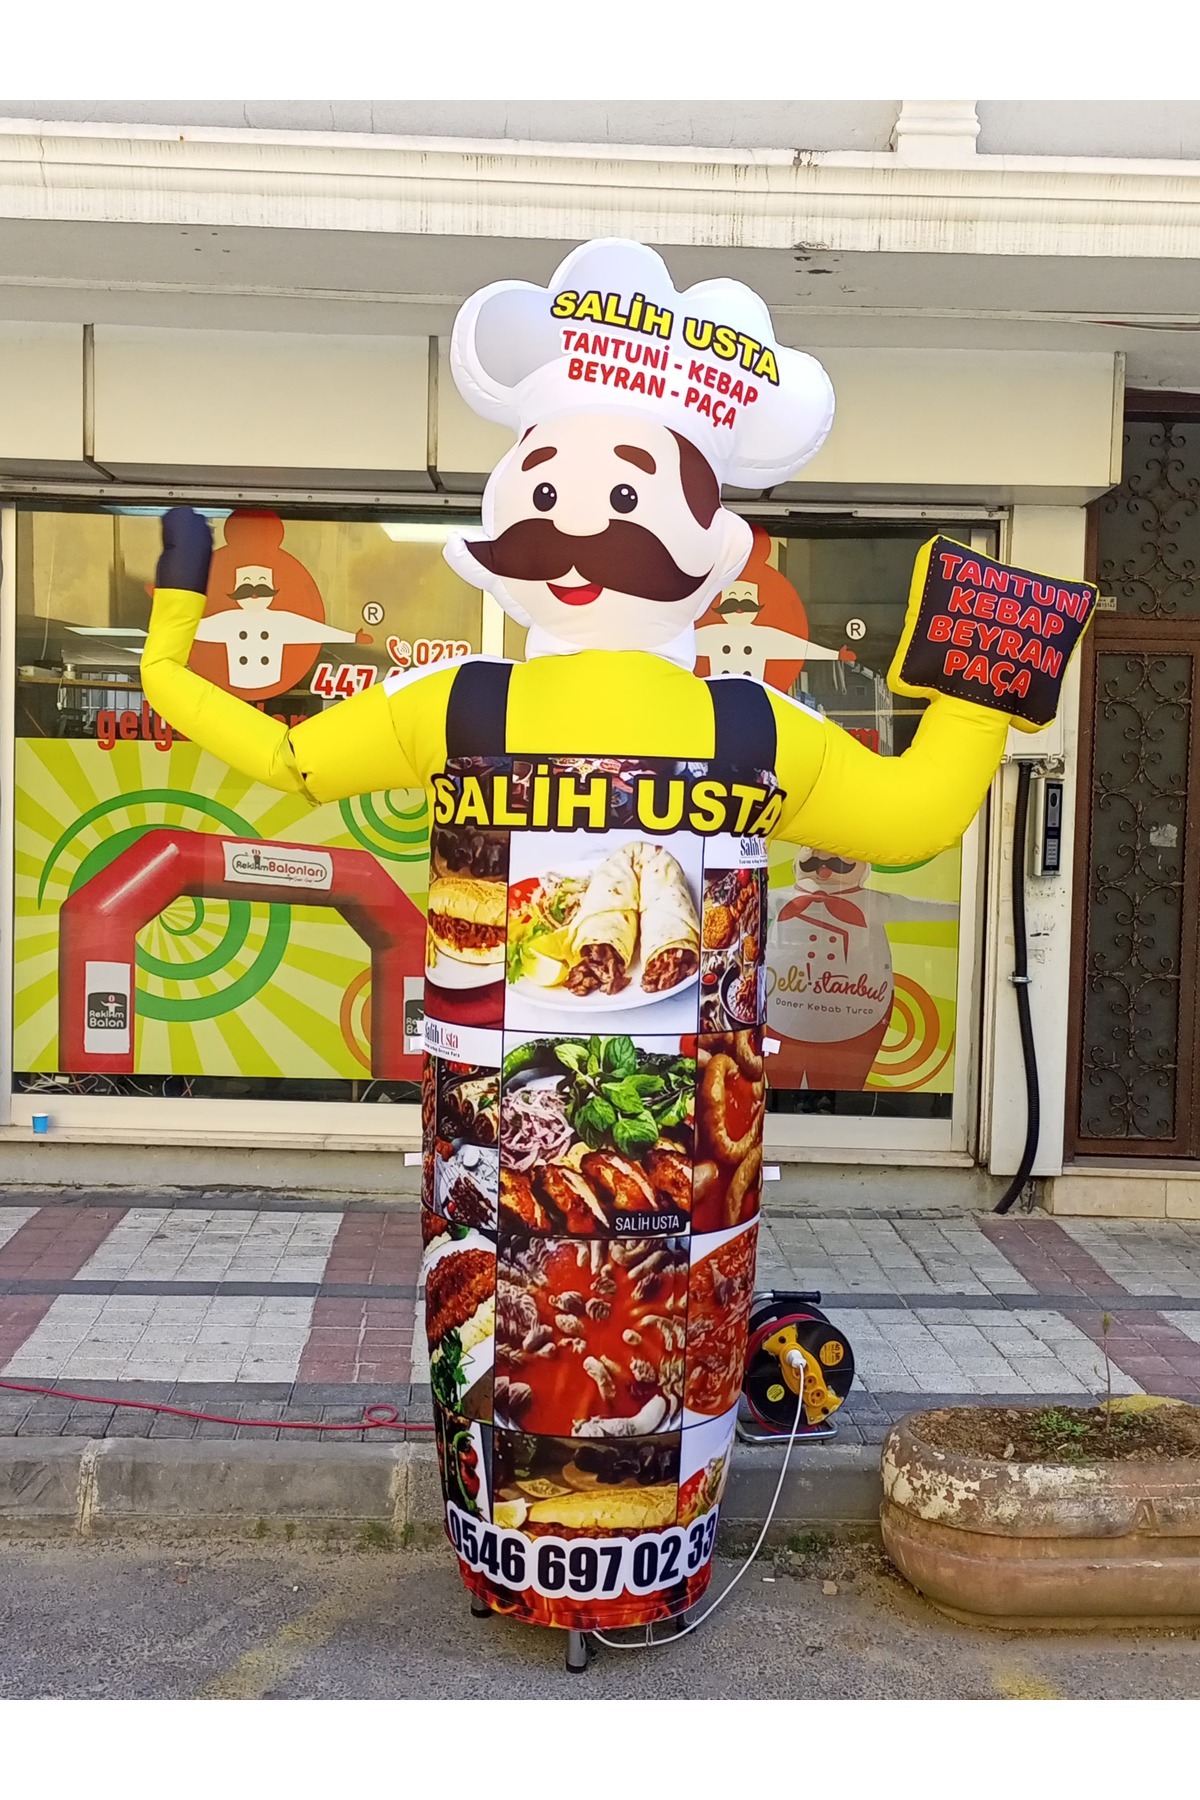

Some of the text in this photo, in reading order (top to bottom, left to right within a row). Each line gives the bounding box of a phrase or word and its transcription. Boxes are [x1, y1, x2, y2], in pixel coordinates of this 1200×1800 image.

[551, 291, 780, 386] SALİH USTA
[563, 330, 670, 371] TANTUNİ
[688, 360, 758, 406] KEBAP
[568, 358, 665, 398] BEYRAN
[684, 387, 736, 429] PAÇA
[948, 586, 1064, 638] KEBAP
[927, 615, 1063, 678] BEYRAN
[943, 649, 1031, 698] PAÇA
[314, 667, 374, 697] 447
[434, 764, 784, 834] SALİH USTA
[89, 1017, 124, 1027] Balon
[776, 997, 874, 1015] Doner Kebab Turco
[615, 1213, 680, 1231] SALİH USTA
[450, 1508, 717, 1593] 0546 697 02 33
